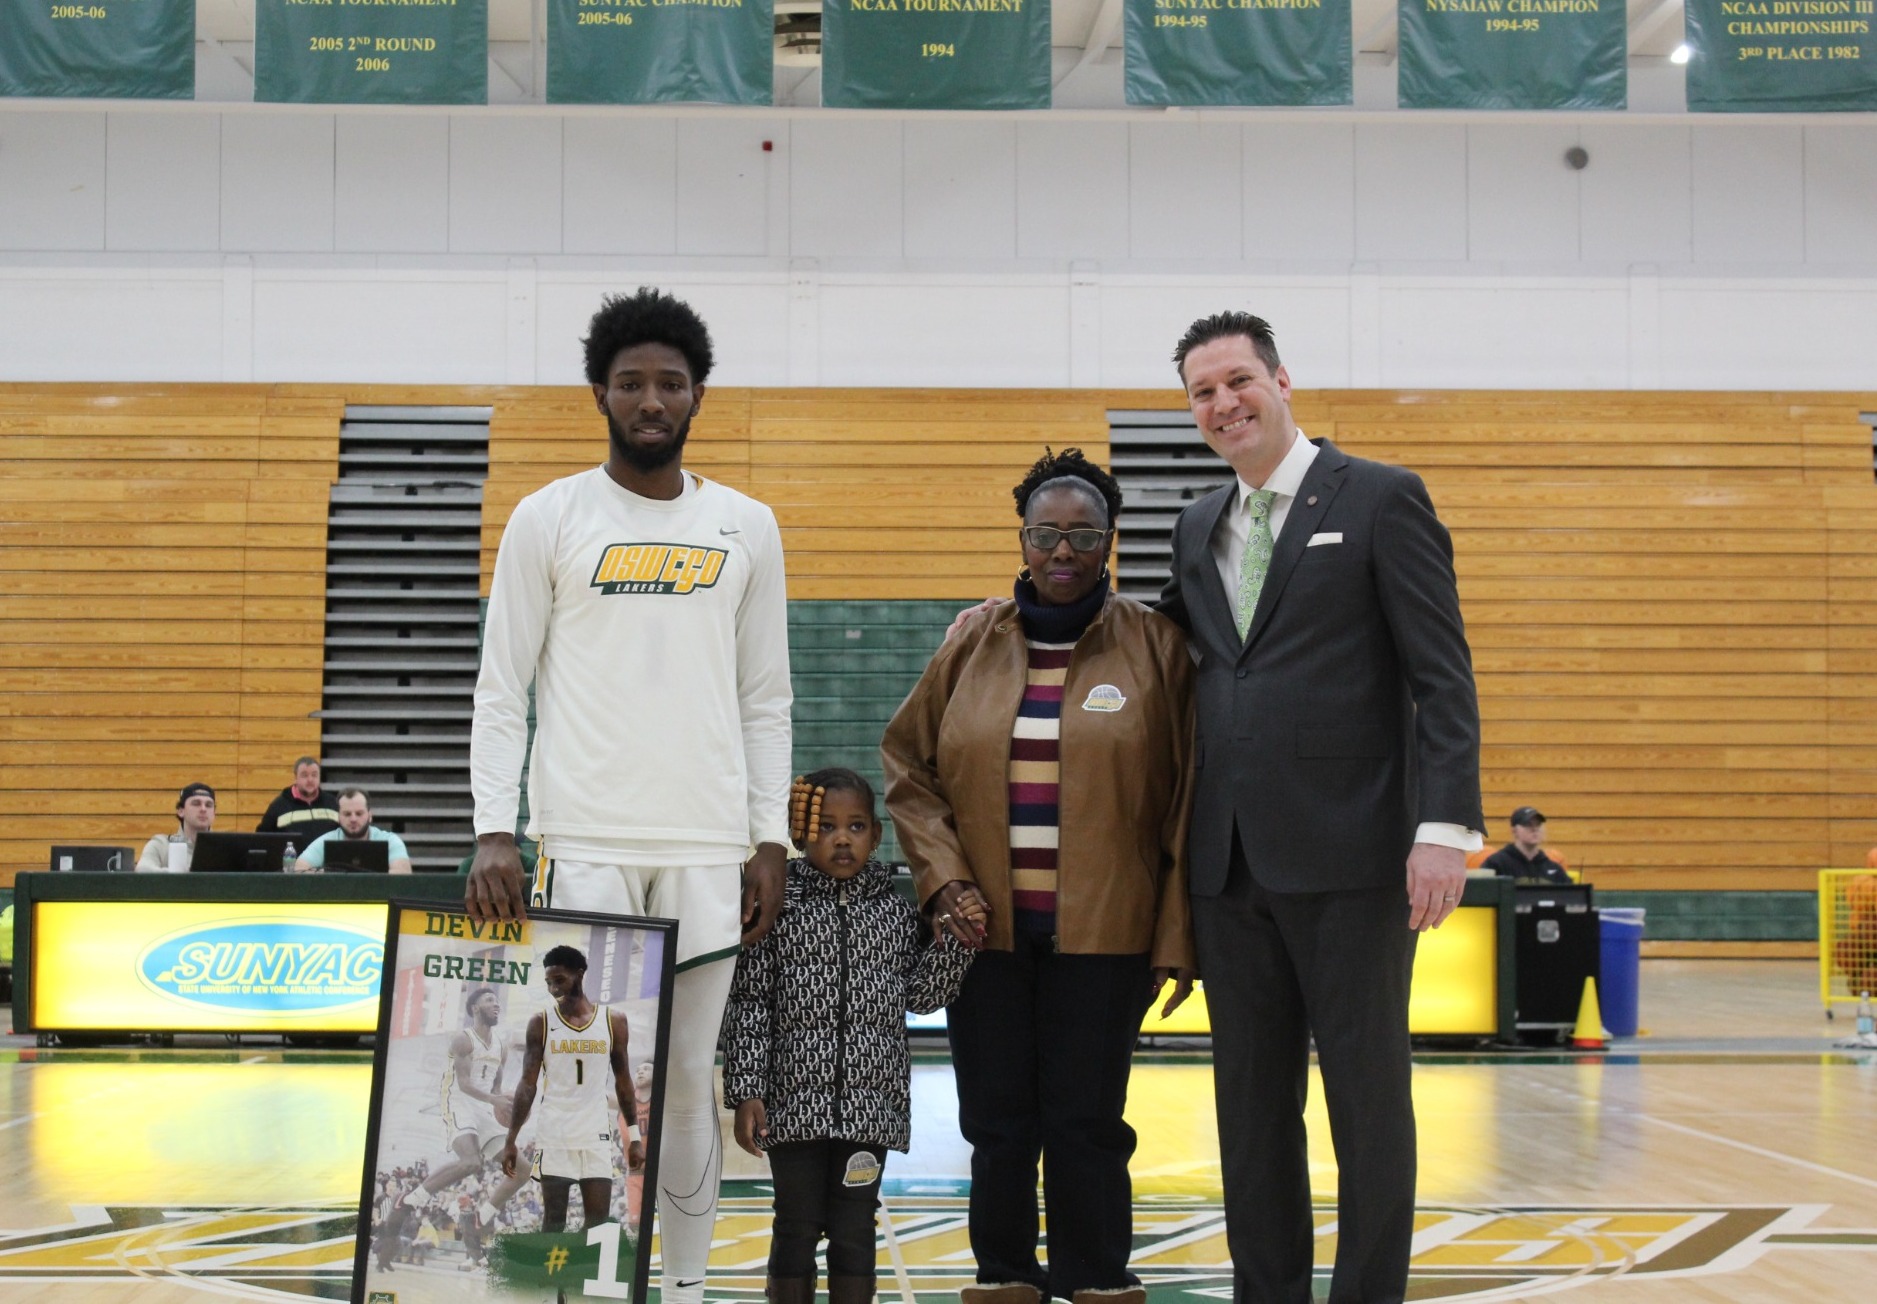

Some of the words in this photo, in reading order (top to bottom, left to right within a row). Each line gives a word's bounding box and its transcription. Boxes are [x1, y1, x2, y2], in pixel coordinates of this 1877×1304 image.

[51, 5, 106, 18] 2005-06
[850, 0, 898, 11] NCAA
[903, 0, 1024, 12] TOURNAMENT
[1426, 0, 1501, 12] NYSAIAW
[1507, 0, 1599, 13] CHAMPION
[1721, 2, 1769, 15] NCAA
[1773, 1, 1850, 15] DIVISION
[1855, 1, 1874, 14] III
[578, 12, 633, 25] 2005-06
[1154, 15, 1208, 27] 1994-95
[1485, 19, 1540, 31] 1994-95
[1727, 20, 1869, 35] CHAMPIONSHIPS
[309, 37, 344, 51] 2005
[375, 37, 436, 51] ROUND
[921, 43, 955, 57] 1994
[1767, 47, 1823, 60] PLACE
[1828, 46, 1860, 59] 1982
[355, 57, 390, 71] 2006
[596, 545, 725, 593] OSWEGO
[615, 583, 665, 592] LAKERS
[424, 912, 523, 943] DEVIN
[171, 941, 385, 985] SUNYAC
[423, 954, 531, 986] GREEN
[551, 1039, 607, 1054] LAKERS
[575, 1059, 583, 1085] 1
